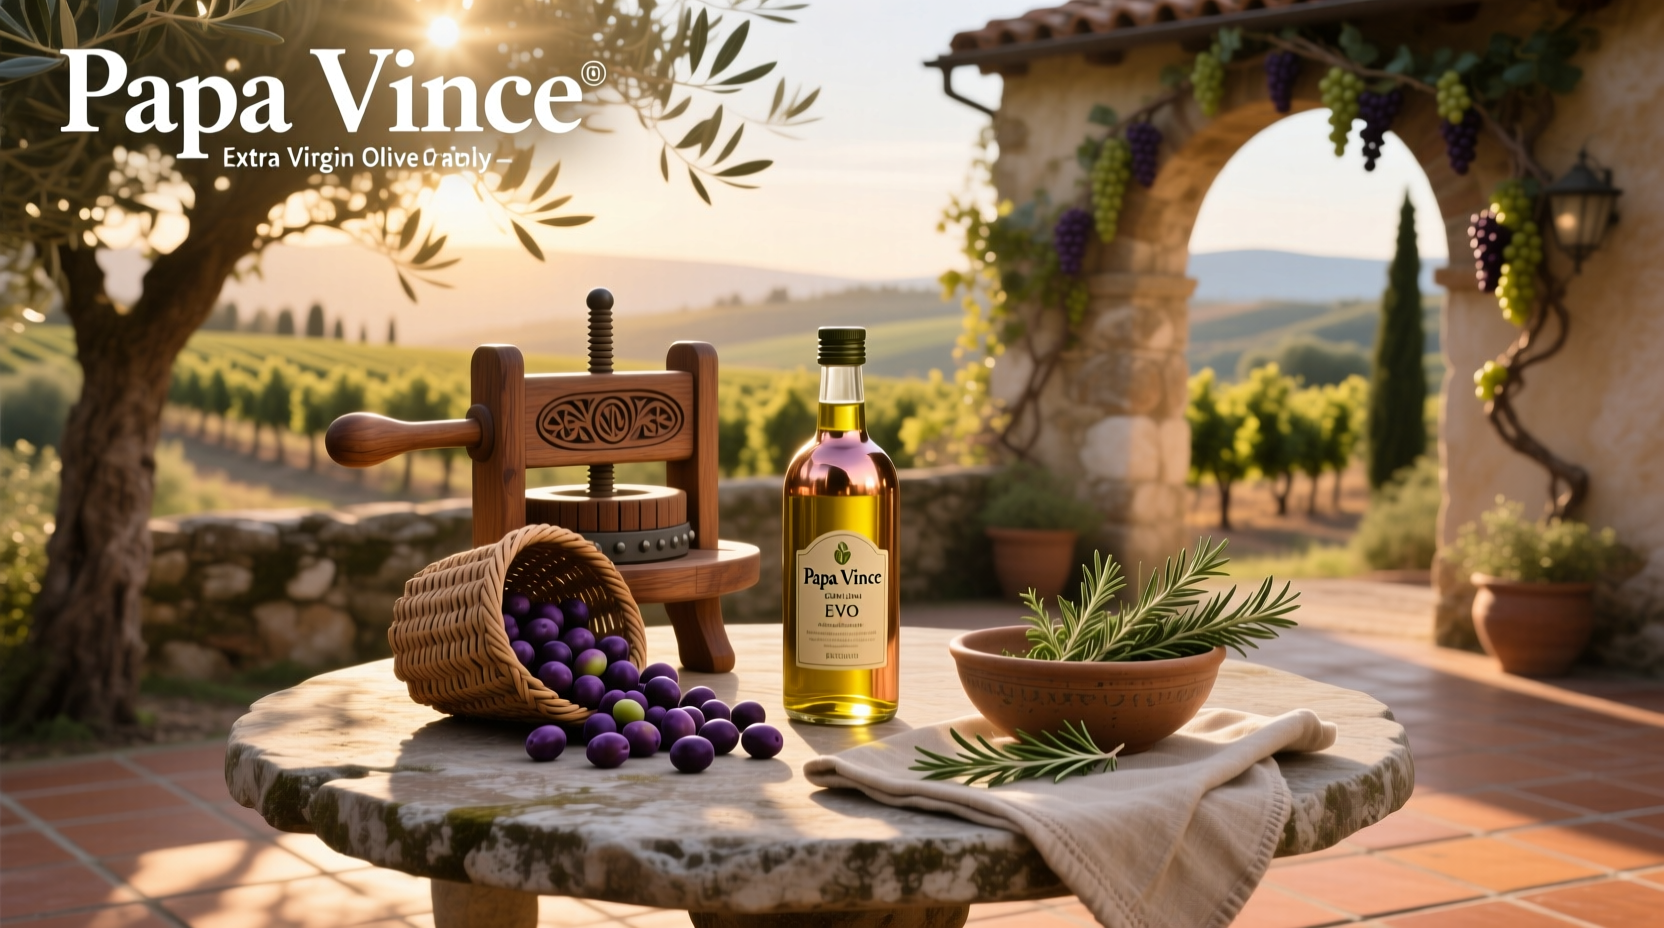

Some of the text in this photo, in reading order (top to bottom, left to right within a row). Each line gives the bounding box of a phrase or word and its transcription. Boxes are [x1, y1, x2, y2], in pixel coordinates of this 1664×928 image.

[803, 567, 882, 590] Papa Vince
[825, 604, 859, 618] EVO
